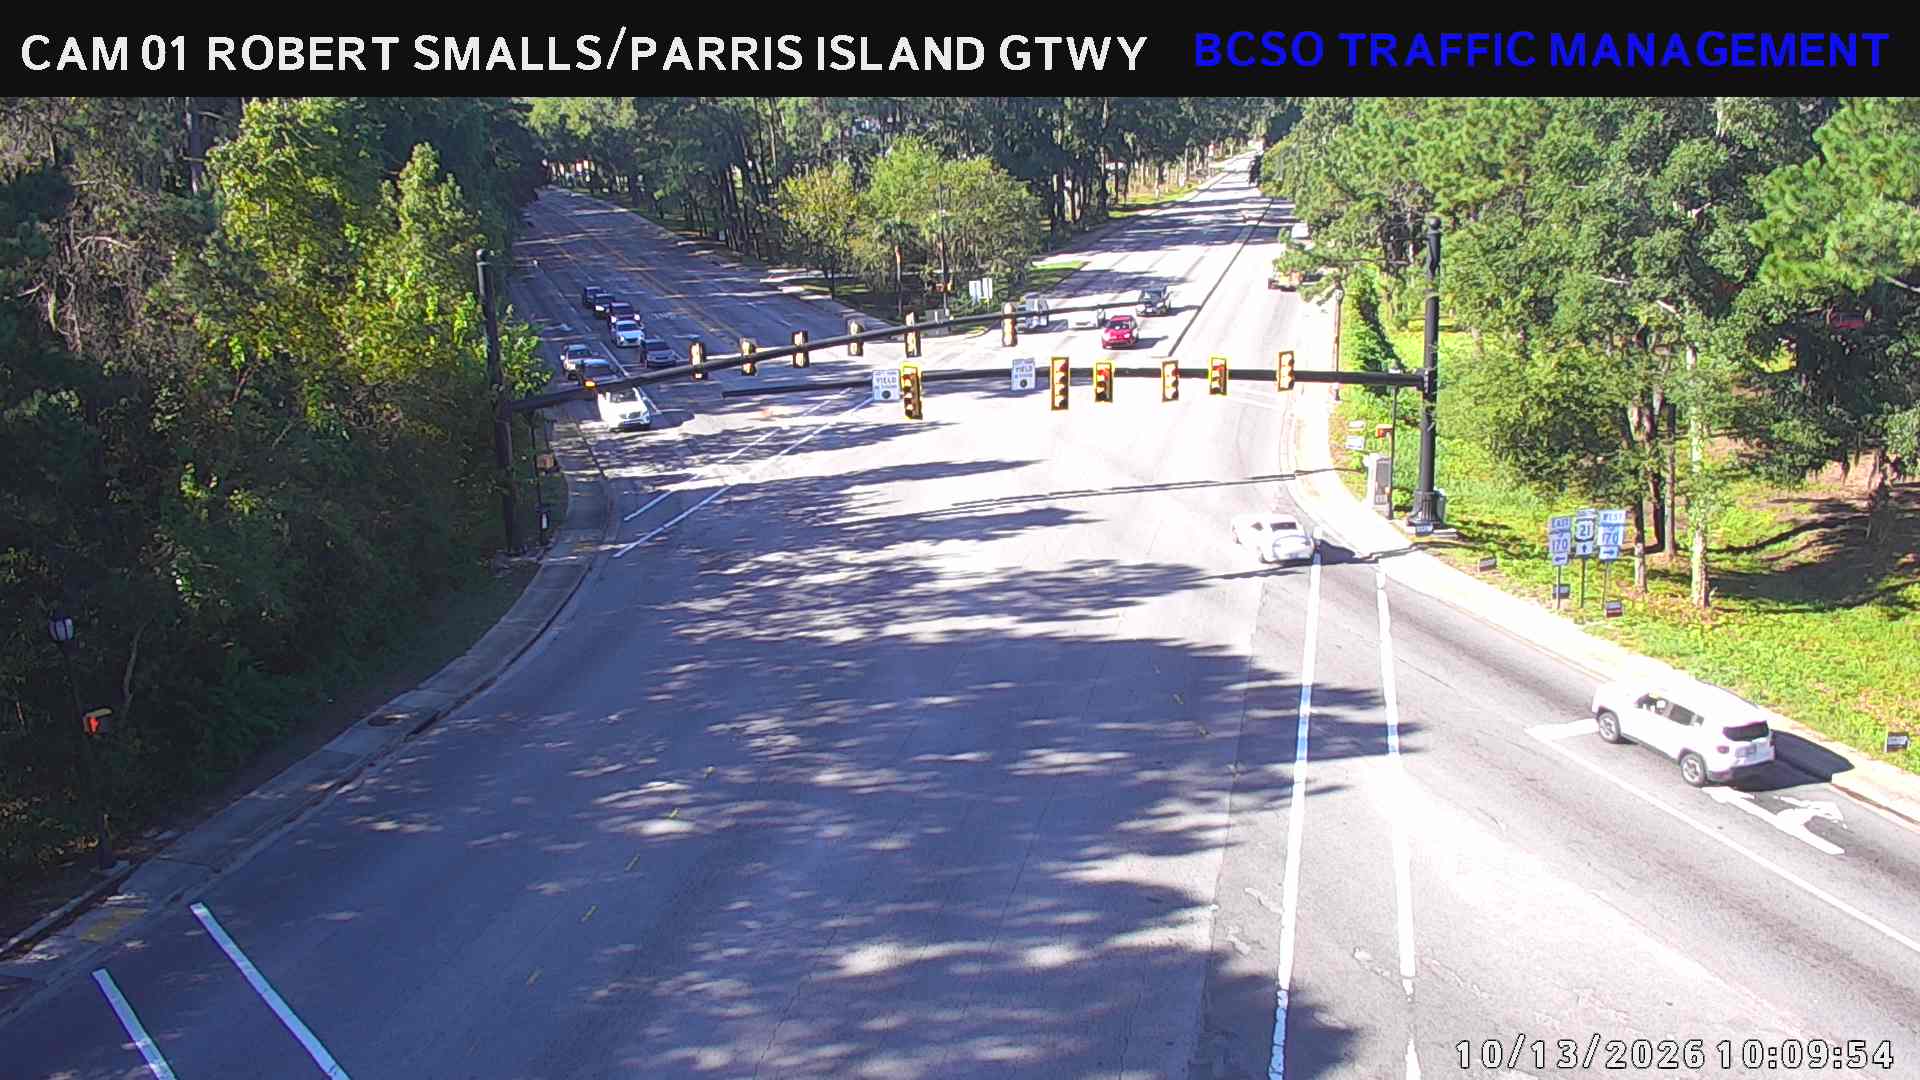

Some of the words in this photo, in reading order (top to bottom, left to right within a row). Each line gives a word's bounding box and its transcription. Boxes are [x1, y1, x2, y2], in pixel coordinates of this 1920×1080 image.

[876, 376, 897, 384] YIELD
[1602, 513, 1623, 521] WEST
[1580, 525, 1590, 537] 21
[1602, 531, 1619, 544] 170
[1552, 538, 1568, 550] 170
